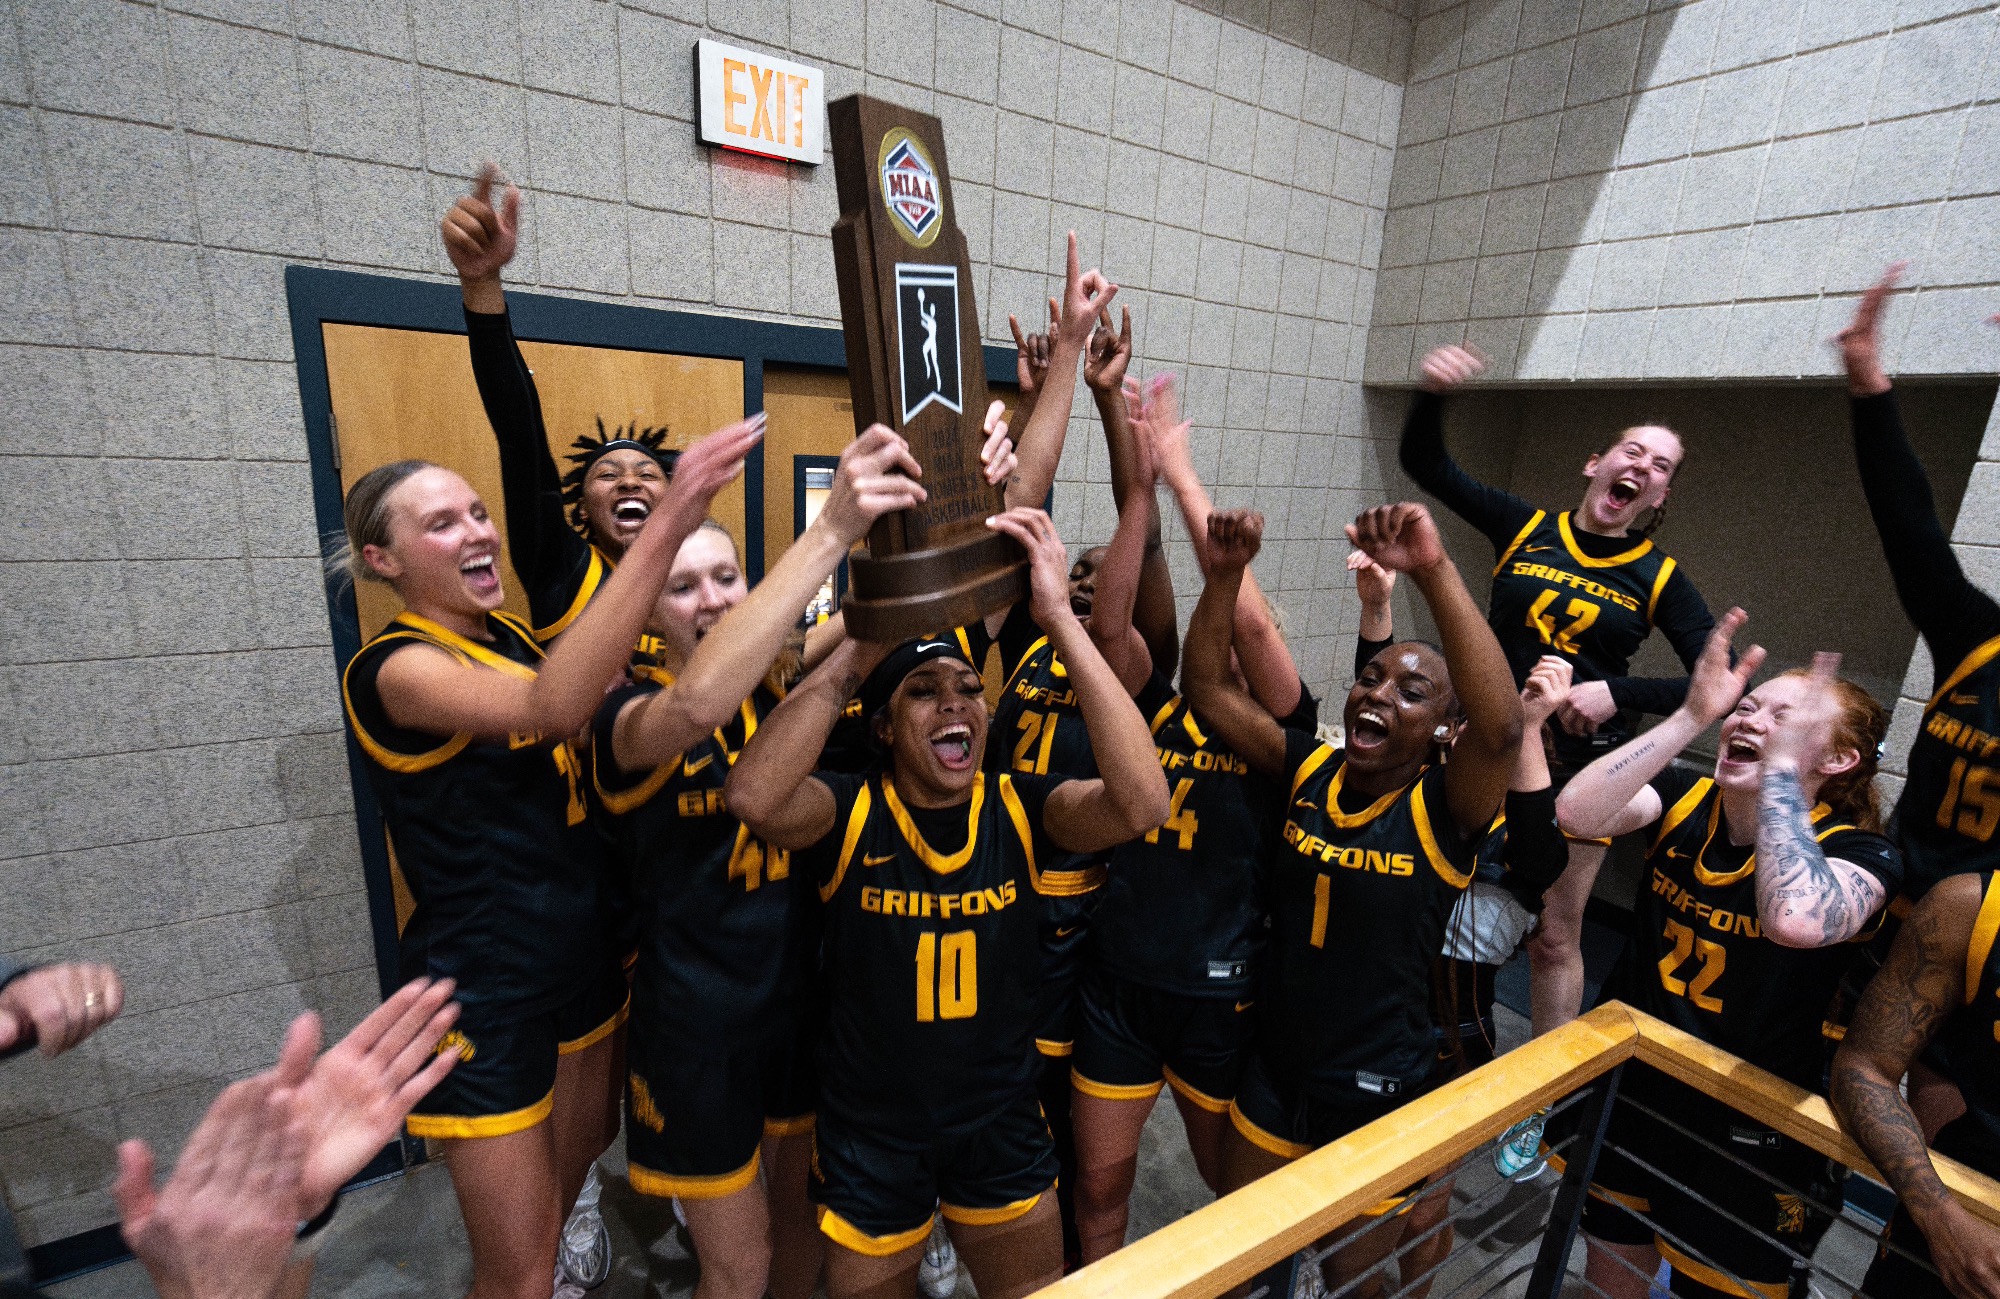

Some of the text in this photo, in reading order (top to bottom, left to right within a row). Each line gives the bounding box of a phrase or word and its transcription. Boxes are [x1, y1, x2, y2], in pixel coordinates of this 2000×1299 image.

[724, 57, 808, 148] EXIT
[889, 174, 935, 205] MIAA
[1512, 562, 1640, 612] GRIFFONS
[1525, 588, 1600, 655] 42
[1012, 709, 1059, 776] 21
[1145, 777, 1199, 851] 4
[1936, 756, 2000, 842] 15
[1283, 818, 1415, 877] GRIFFONS
[860, 879, 1017, 920] GRIFFONS
[1310, 872, 1331, 949] 1
[1652, 867, 1768, 939] GRIFFON
[915, 928, 978, 1023] 10
[1658, 916, 1727, 1014] 22
[1766, 1137, 1776, 1145] M
